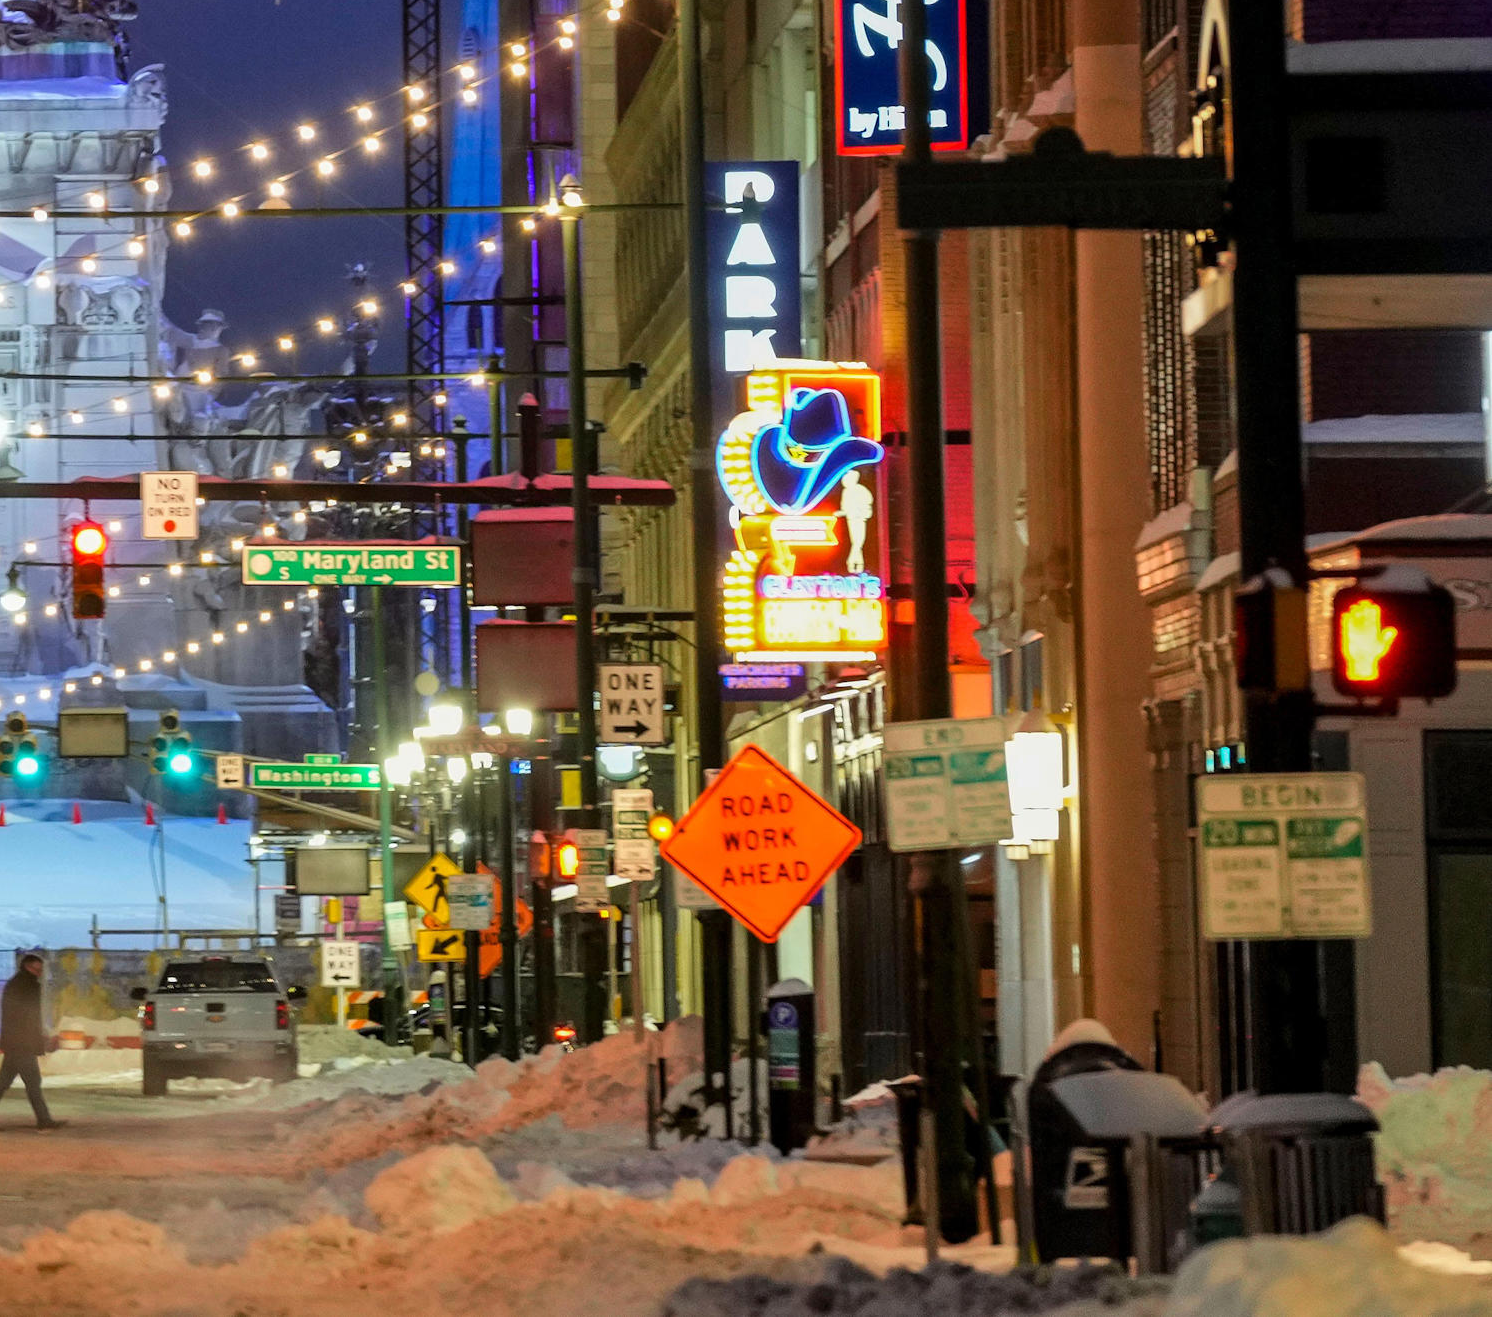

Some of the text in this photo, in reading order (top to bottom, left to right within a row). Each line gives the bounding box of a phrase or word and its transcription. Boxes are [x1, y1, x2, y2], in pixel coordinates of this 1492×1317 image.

[849, 107, 878, 138] by
[725, 171, 778, 372] PARK
[158, 479, 180, 490] NO
[154, 493, 185, 504] TURN
[147, 507, 192, 517] ON RED
[303, 551, 415, 575] Maryland
[426, 551, 450, 570] St
[279, 566, 290, 580] S
[313, 574, 367, 584] ONE WAY
[608, 673, 654, 691] ONE
[607, 698, 656, 716] WAY
[923, 726, 964, 746] END
[258, 770, 380, 786] Washington S
[1242, 785, 1320, 806] BEGIN
[721, 793, 794, 817] ROAD
[722, 828, 797, 852] WORK
[721, 861, 810, 887] AHEAD
[327, 946, 354, 956] ONE
[328, 960, 355, 969] WAY
